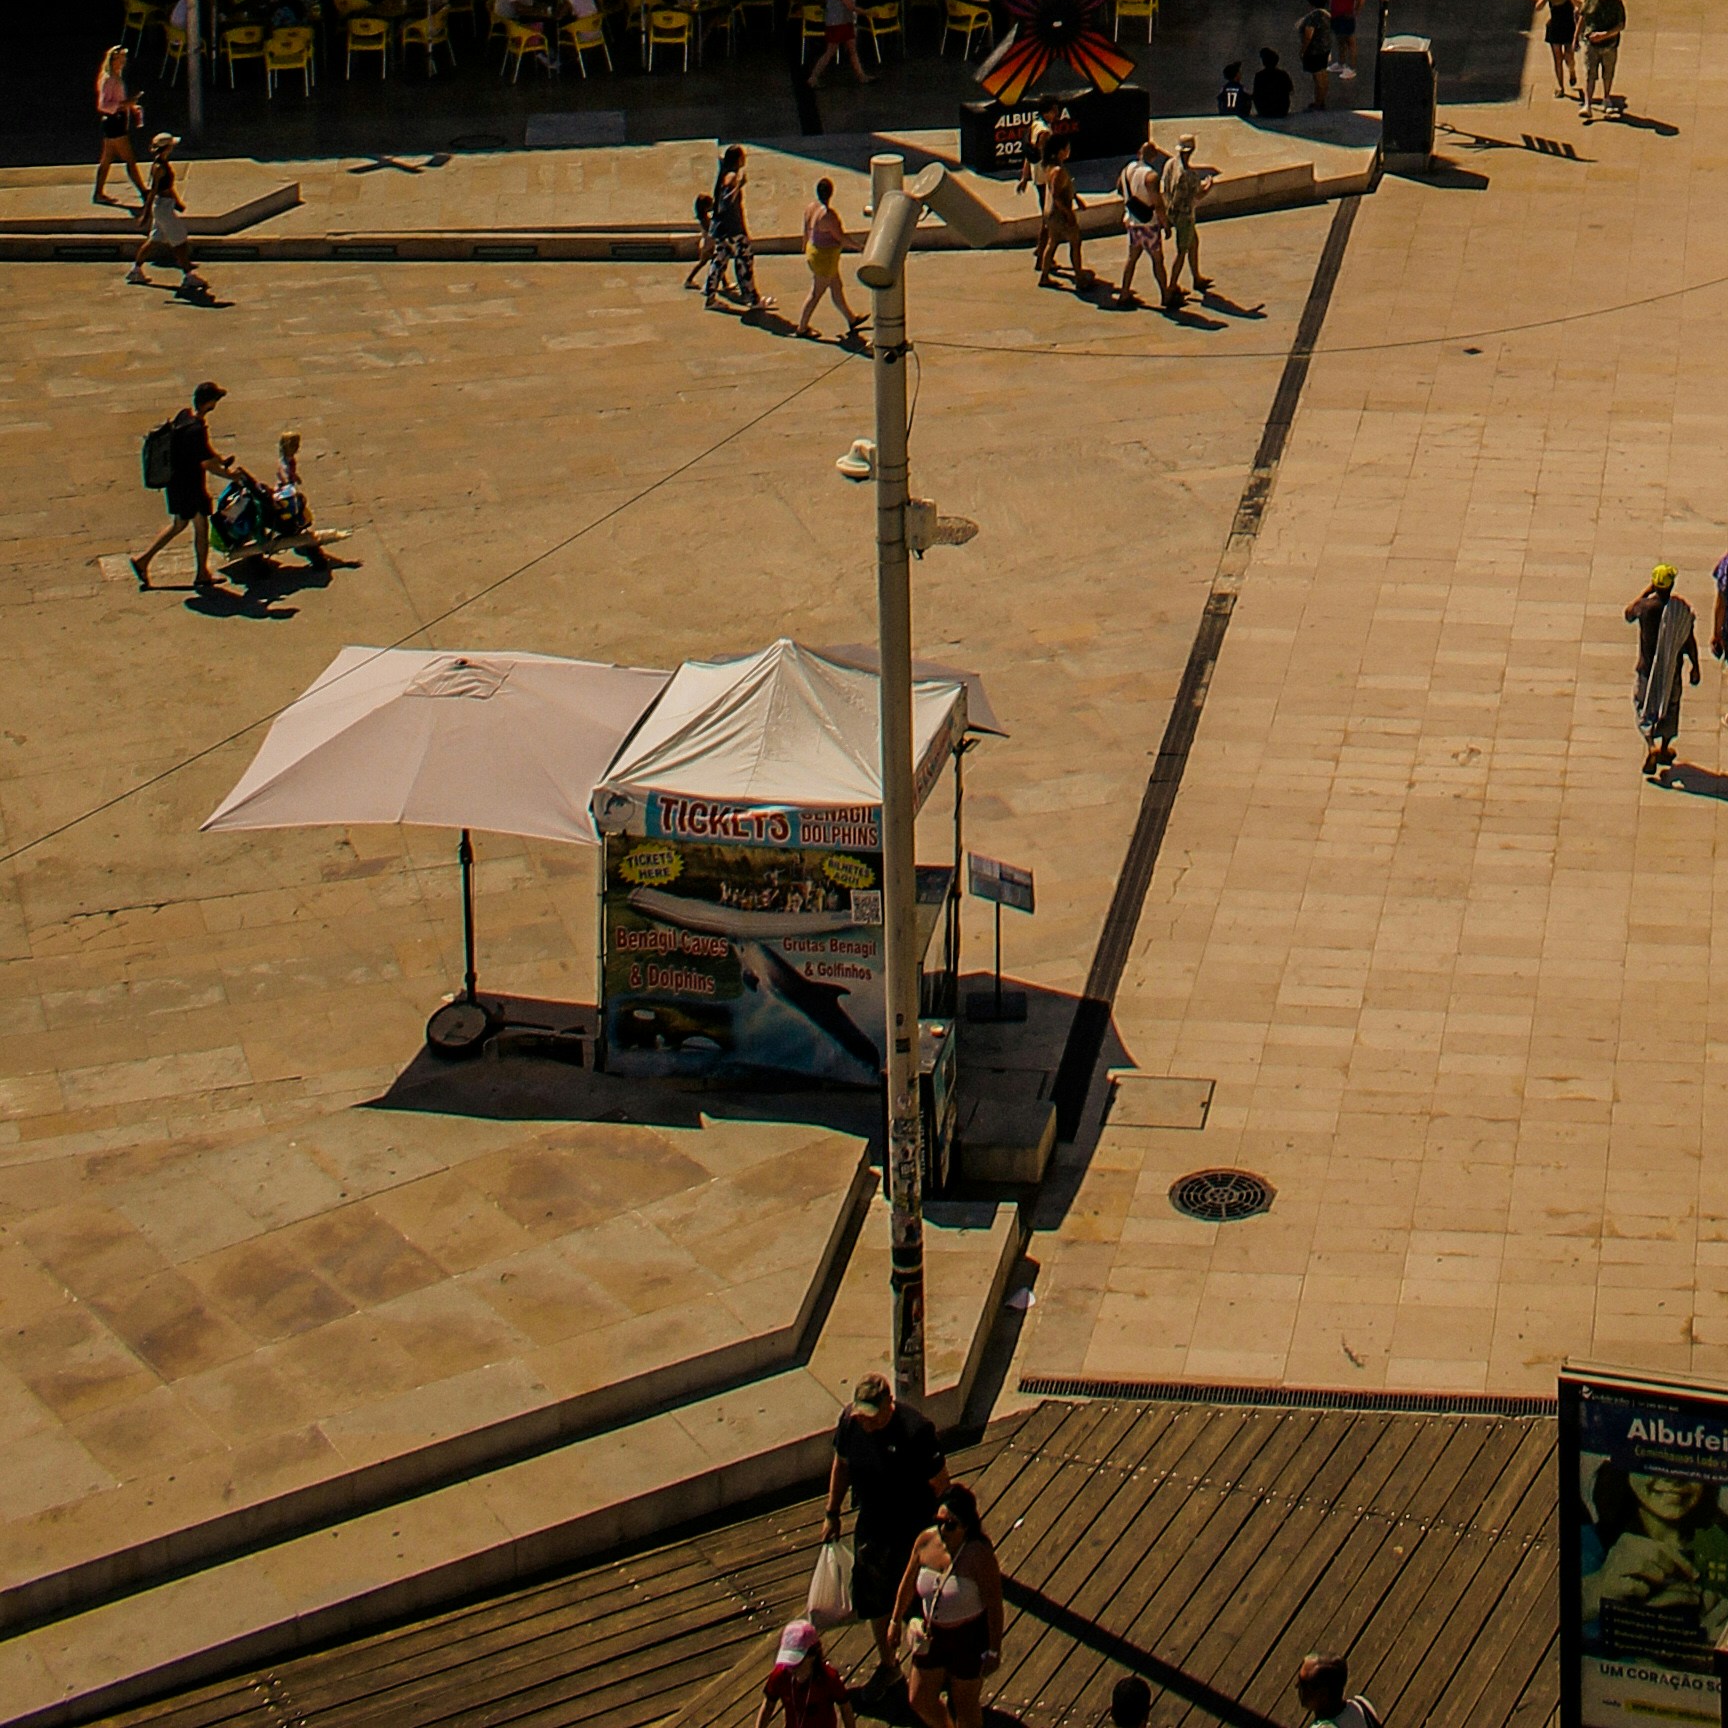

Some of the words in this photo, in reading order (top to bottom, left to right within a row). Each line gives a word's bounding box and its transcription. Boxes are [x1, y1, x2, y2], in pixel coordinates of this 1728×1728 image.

[1227, 91, 1238, 108] 17
[994, 106, 1071, 129] ALBUFA
[996, 141, 1024, 157] 202
[659, 796, 792, 841] TICKETS
[801, 825, 878, 846] DOLPHINS
[627, 852, 674, 867] TICKETS
[637, 867, 670, 879] HERE
[616, 927, 676, 952] Benagil
[681, 933, 729, 957] Caves
[783, 937, 826, 953] Grutas
[830, 938, 876, 958] Benagil
[630, 965, 642, 987] &
[648, 965, 716, 994] Dolphins
[804, 961, 814, 976] &
[817, 962, 872, 981] Golfinhos
[1600, 1663, 1623, 1678] UM
[1626, 1667, 1703, 1691] CORAÇÃO
